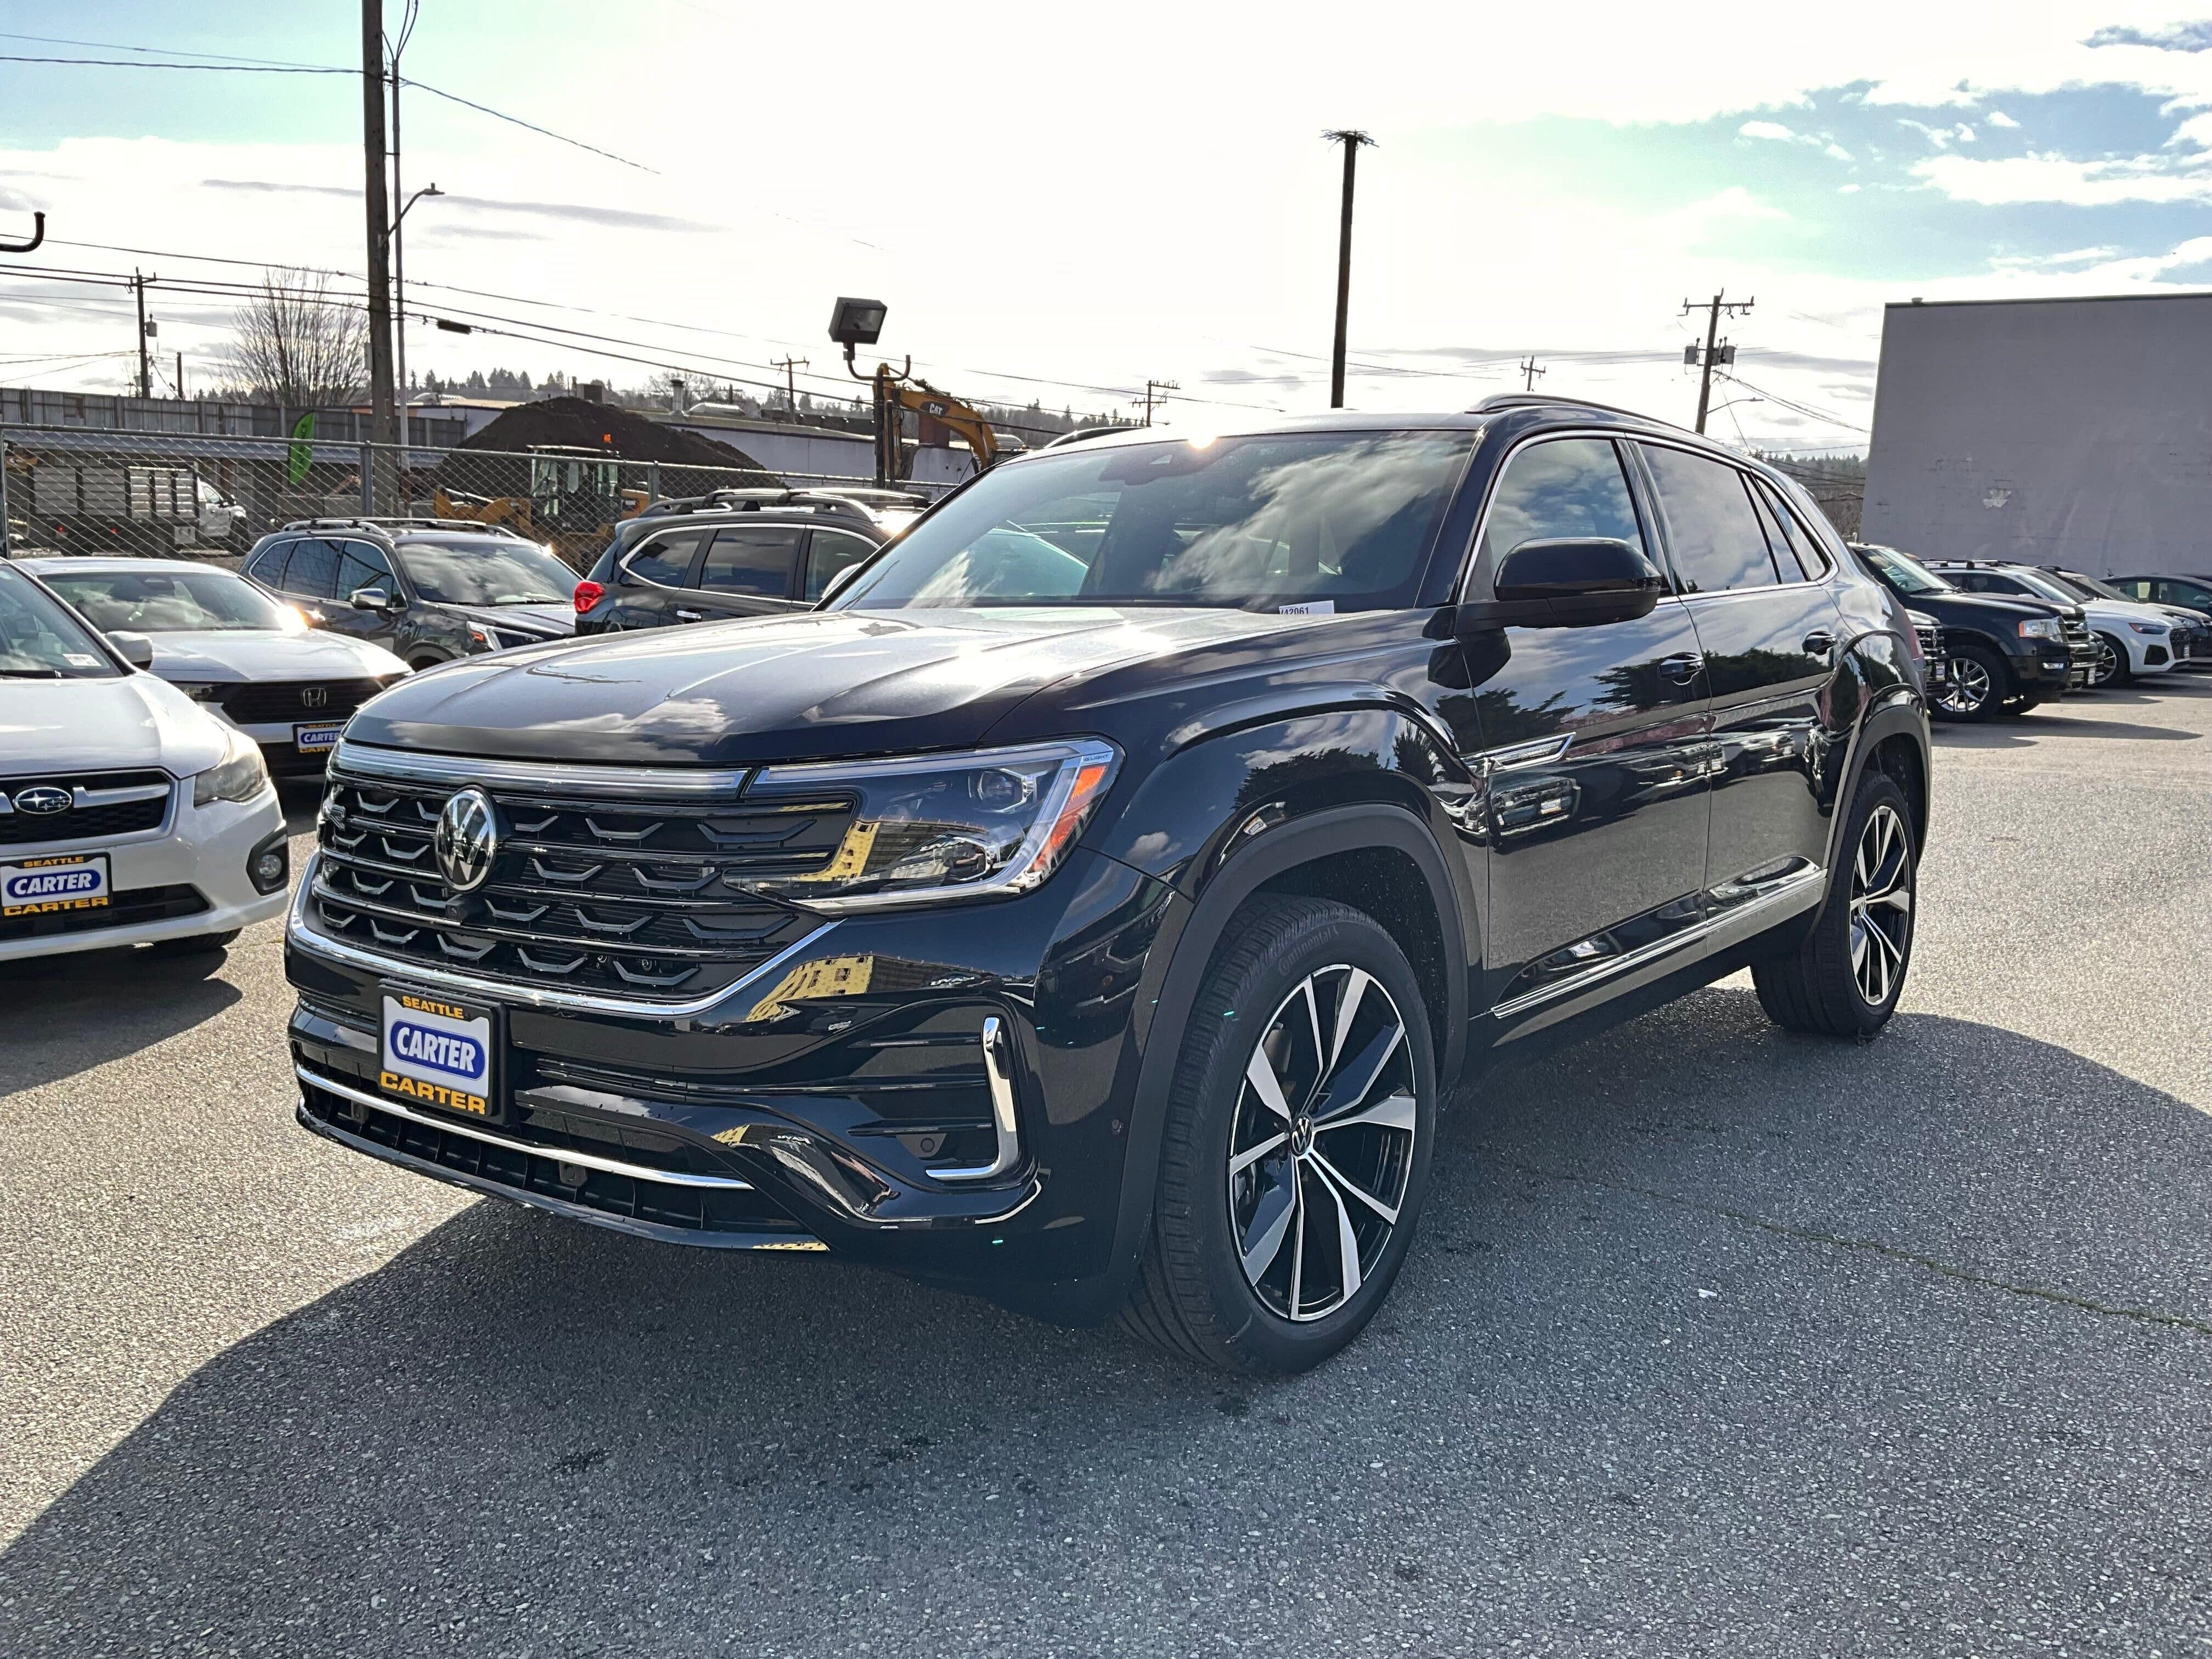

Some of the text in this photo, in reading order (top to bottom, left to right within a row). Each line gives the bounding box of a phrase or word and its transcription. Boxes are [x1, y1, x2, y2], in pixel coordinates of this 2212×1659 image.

[929, 403, 943, 415] CAT
[24, 856, 84, 868] SEATTLE
[14, 873, 92, 895] CARTER
[4, 897, 108, 916] CARTER
[402, 996, 464, 1019] SEATTLE
[397, 1026, 476, 1073] CARTER
[380, 1071, 486, 1115] CARTER
